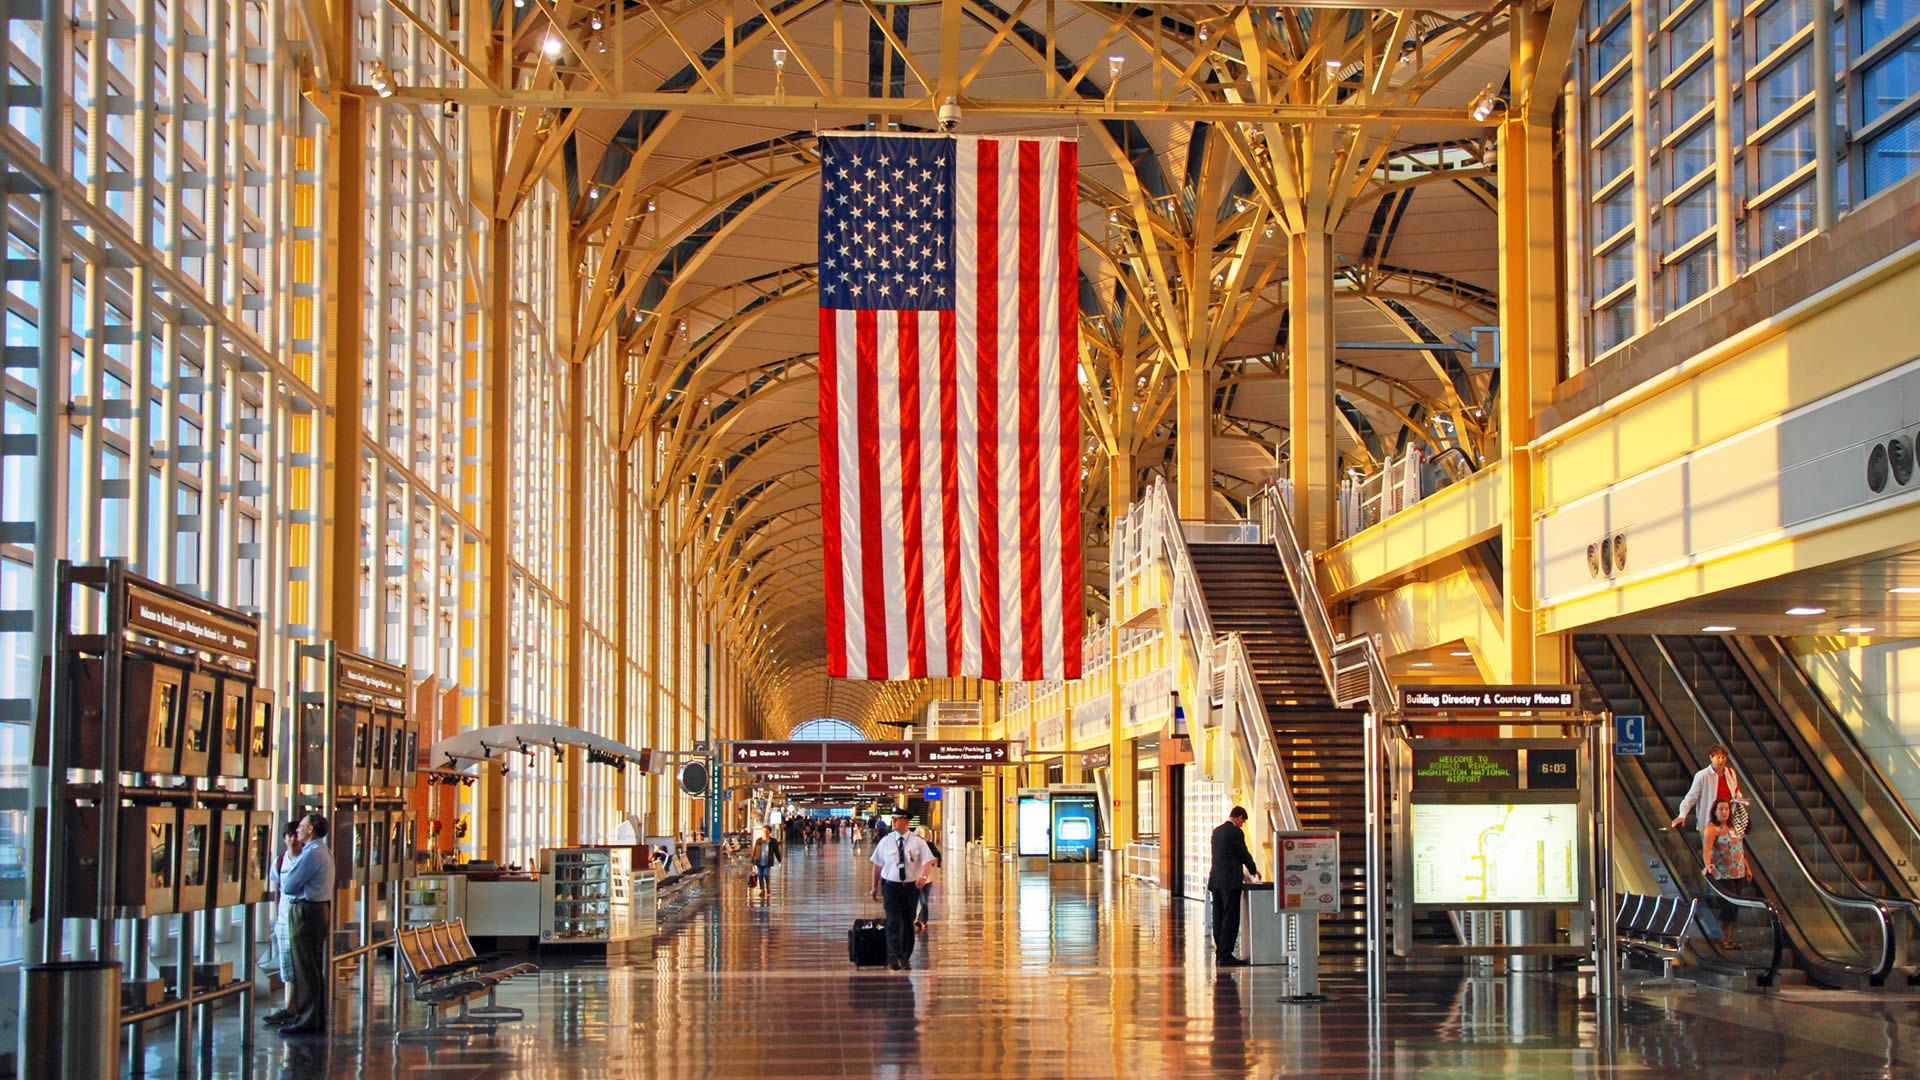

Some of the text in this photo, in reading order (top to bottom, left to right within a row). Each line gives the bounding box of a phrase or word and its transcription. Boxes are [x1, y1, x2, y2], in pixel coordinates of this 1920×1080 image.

[1406, 693, 1560, 707] Building Directory & Courtesy Phone
[1439, 755, 1489, 763] WELCOME TO
[1429, 762, 1499, 770] RONALD REAGAN
[1542, 763, 1567, 774] 6:03
